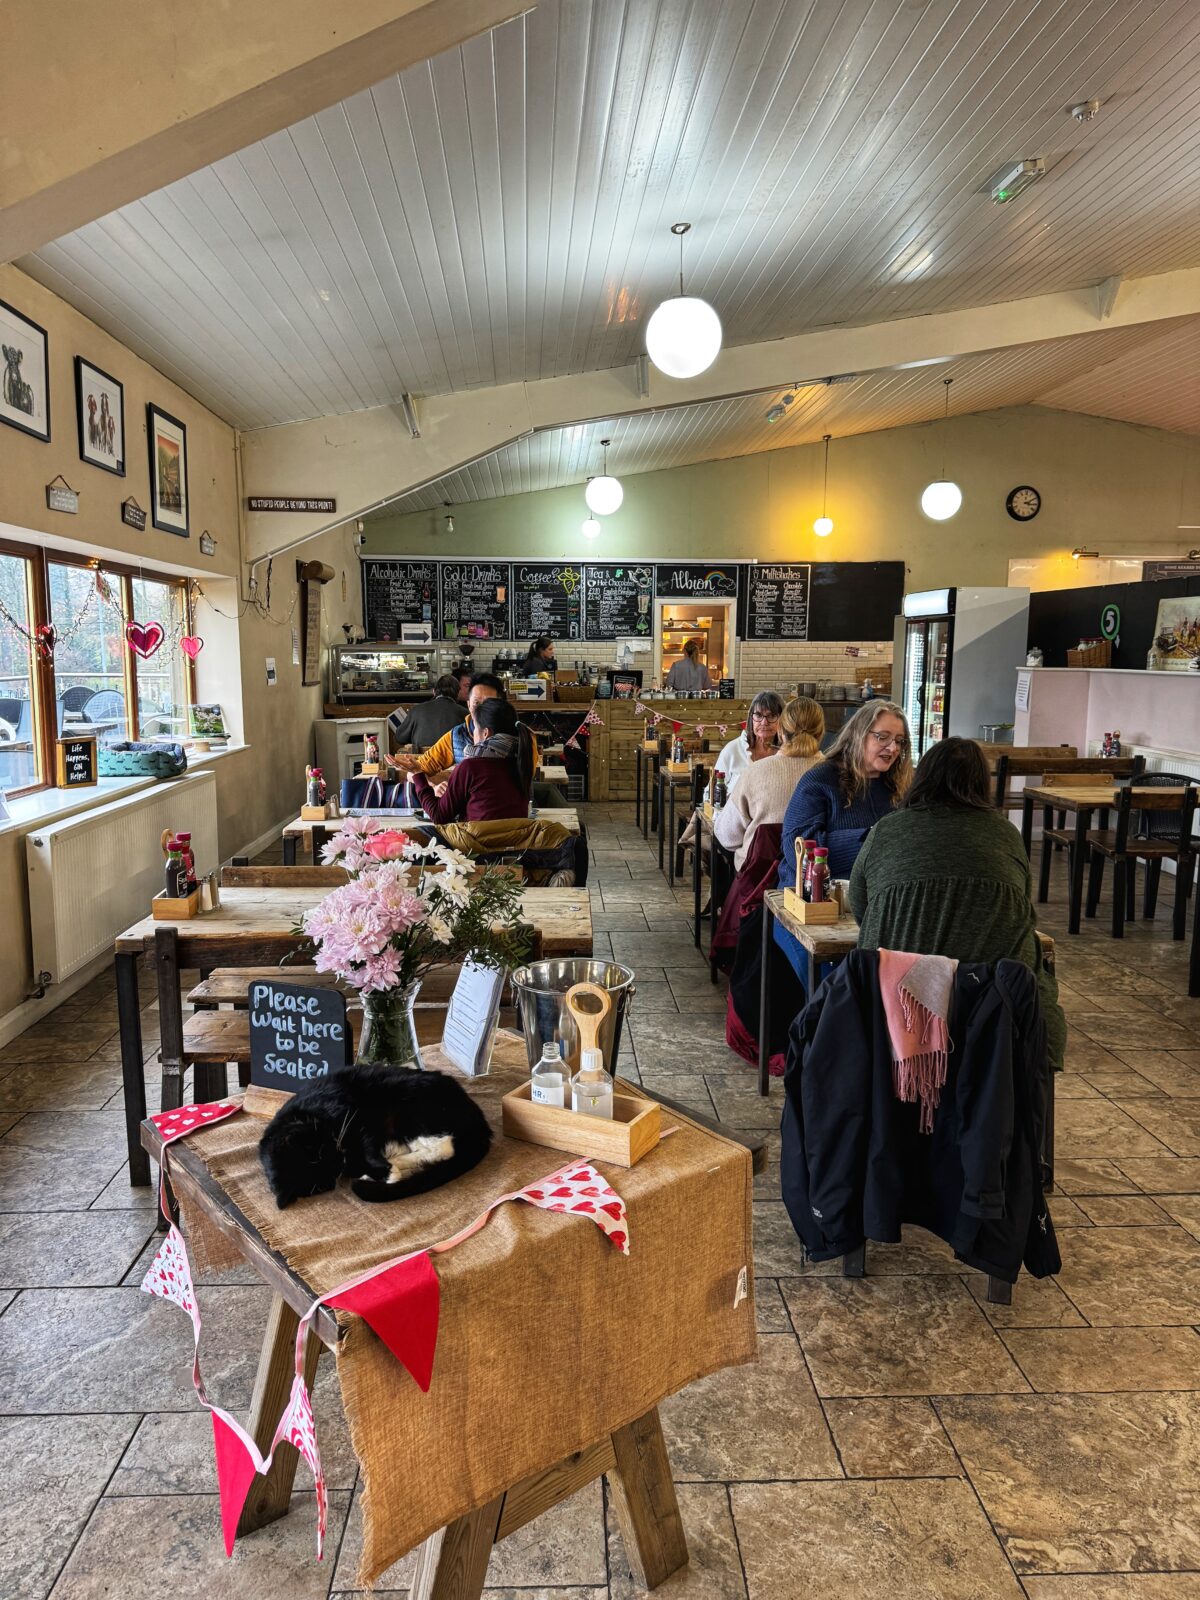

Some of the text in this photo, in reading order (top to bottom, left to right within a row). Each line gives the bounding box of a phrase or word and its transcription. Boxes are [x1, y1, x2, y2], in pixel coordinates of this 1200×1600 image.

[251, 499, 333, 510] NO STUPID PEOPLE BEYOND THIS POINT!
[370, 563, 431, 579] Alcoholic Drinks
[443, 565, 502, 581] Cold Drinks
[520, 567, 552, 585] Coffee
[587, 567, 604, 579] Tea
[670, 570, 715, 591] Albion
[1105, 610, 1115, 633] 5
[71, 743, 83, 753] Life
[65, 754, 90, 763] Happens,
[73, 763, 83, 771] GIN
[70, 771, 87, 781] Helps!
[253, 985, 322, 1016] Please
[301, 1015, 344, 1041] here
[275, 1031, 322, 1056] to be
